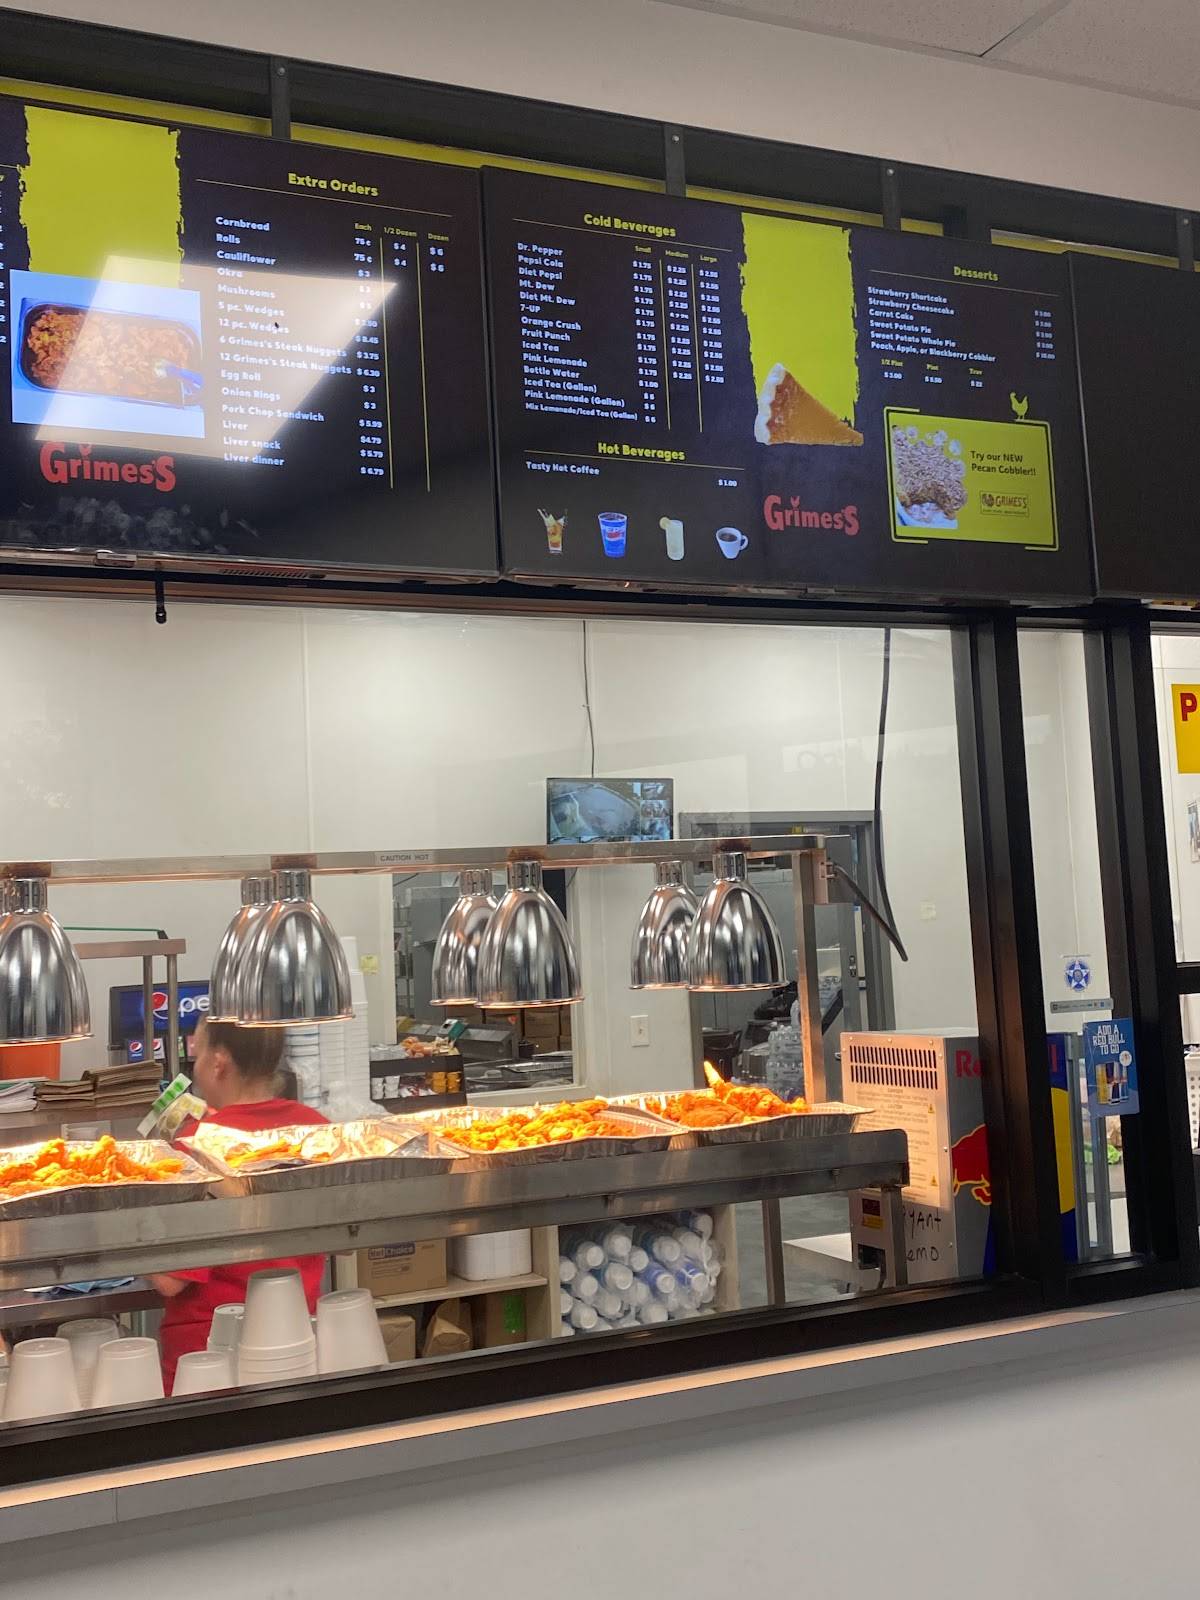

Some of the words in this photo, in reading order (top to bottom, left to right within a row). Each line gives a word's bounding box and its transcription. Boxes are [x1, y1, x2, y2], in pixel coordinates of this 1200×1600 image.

[288, 172, 327, 190] Extra
[330, 180, 379, 196] Orders
[216, 216, 270, 231] Cornbread
[584, 214, 612, 228] Cold
[614, 218, 676, 238] Beverages
[216, 234, 240, 244] Rolls
[518, 242, 531, 252] Dr.
[532, 244, 563, 256] Pepper
[216, 250, 276, 266] Cauliflower
[518, 254, 542, 266] Pepsi
[544, 259, 564, 268] Cola
[217, 268, 243, 278] Okra
[518, 267, 537, 276] Diet
[539, 270, 562, 280] Pepsi
[954, 266, 998, 281] Desserts
[218, 284, 276, 298] Mushrooms
[519, 280, 534, 288] Mt.
[536, 282, 555, 292] Dew
[520, 291, 538, 301] Diet
[540, 294, 554, 303] Mt.
[556, 296, 576, 306] Dew
[868, 286, 909, 300] Strawberry
[911, 292, 947, 304] Shortcake
[245, 304, 285, 317] Wedges
[520, 304, 541, 313] 7-UP
[868, 298, 910, 310] Strawberry
[912, 303, 954, 315] Cheesecake
[869, 308, 894, 318] Carrot
[895, 312, 914, 320] Cake
[219, 318, 230, 327] 12
[232, 320, 248, 330] pc.
[249, 322, 290, 335] Wedges
[521, 316, 554, 328] Orange
[556, 320, 582, 331] Crush
[870, 320, 893, 330] Sweet
[894, 322, 918, 332] Potato
[920, 326, 932, 334] Pie
[522, 328, 542, 338] Fruit
[544, 331, 571, 342] Punch
[870, 331, 894, 340] Sweet
[895, 334, 920, 344] Potato
[921, 336, 943, 346] Whole
[944, 340, 956, 348] Pie
[229, 336, 272, 348] Grimes's
[275, 341, 304, 352] Steak
[306, 344, 348, 357] Nuggets
[522, 340, 542, 350] Iced
[542, 343, 560, 352] Tea
[871, 341, 895, 351] Peach,
[896, 344, 919, 354] Apple,
[930, 348, 968, 360] Blackberry
[968, 352, 996, 362] Cobbler
[220, 352, 230, 361] 12
[233, 354, 277, 366] Grimes's
[280, 359, 308, 370] Steak
[311, 363, 352, 374] Nuggets
[522, 352, 542, 362] Pink
[544, 355, 588, 368] Lemonade
[220, 370, 240, 381] Egg
[242, 372, 261, 382] Roll
[524, 365, 551, 376] Bottle
[552, 368, 580, 379] Water
[524, 378, 544, 387] Iced
[544, 380, 561, 389] Tea
[562, 382, 598, 394] (Gallon)
[222, 387, 252, 398] Onion
[254, 390, 280, 402] Rings
[524, 390, 544, 399] Pink
[546, 392, 590, 404] Lemonade
[591, 396, 625, 408] (Gallon)
[222, 404, 246, 414] Pork
[248, 406, 274, 418] Chop
[277, 408, 325, 422] Sandwich
[223, 420, 248, 430] Liver
[224, 436, 248, 447] Liver
[251, 440, 281, 450] snack
[224, 452, 250, 463] Liver
[252, 454, 285, 466] dinner
[598, 442, 620, 455] Hot
[622, 444, 686, 462] Beverages
[970, 450, 984, 462] Try
[1003, 454, 1023, 463] NEW
[526, 461, 551, 473] Tasty
[552, 463, 568, 472] Hot
[570, 464, 600, 476] Coffee
[972, 463, 996, 473] Pecan
[998, 465, 1036, 476] Cobbler!!
[380, 854, 412, 862] CAUTION
[1098, 1024, 1112, 1036] ADD
[1114, 1024, 1120, 1034] A
[1092, 1034, 1107, 1046] RED
[1108, 1034, 1126, 1044] BULL
[1100, 1045, 1108, 1055] TO
